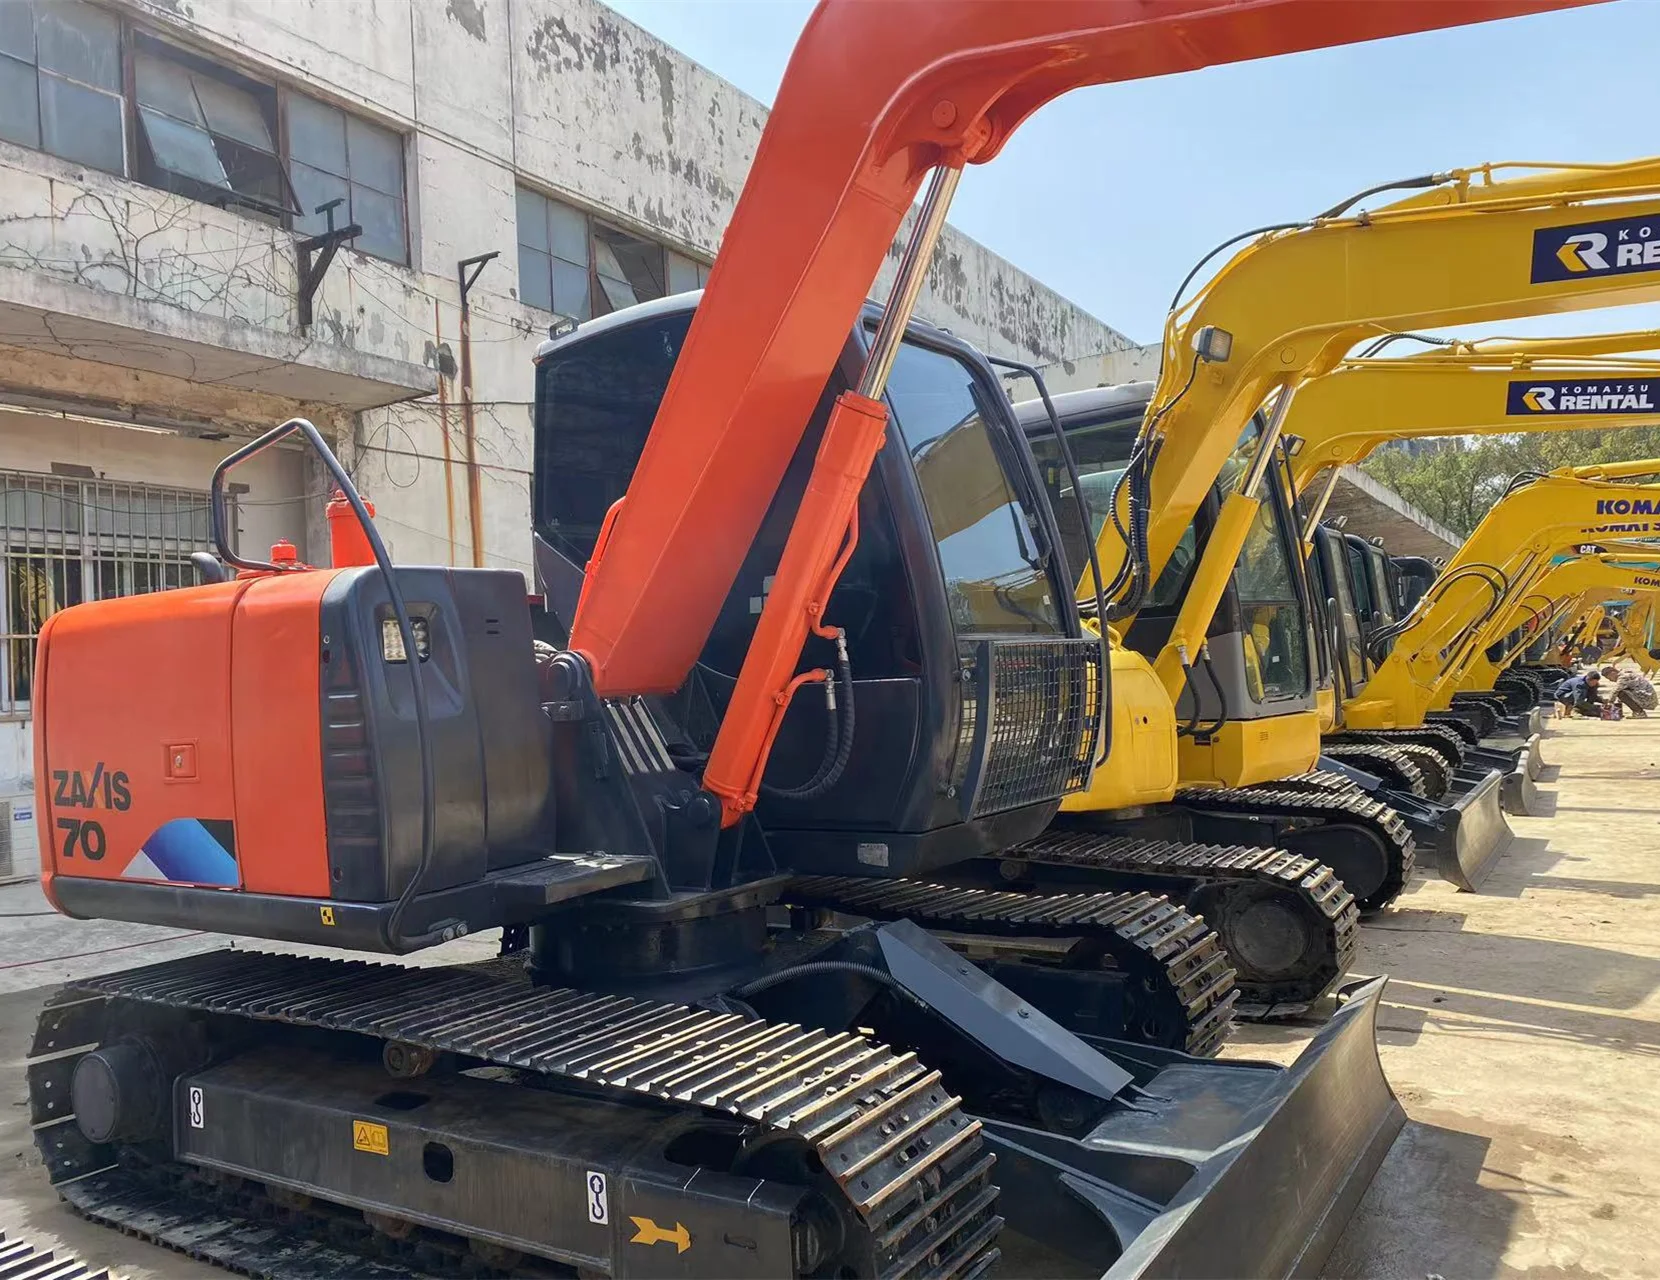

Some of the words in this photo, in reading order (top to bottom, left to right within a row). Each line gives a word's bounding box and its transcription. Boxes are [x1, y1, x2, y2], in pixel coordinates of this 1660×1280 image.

[1561, 384, 1649, 394] KOMATSU
[1560, 394, 1654, 410] RENTAL
[1580, 545, 1597, 554] CAT
[57, 817, 106, 861] 70
